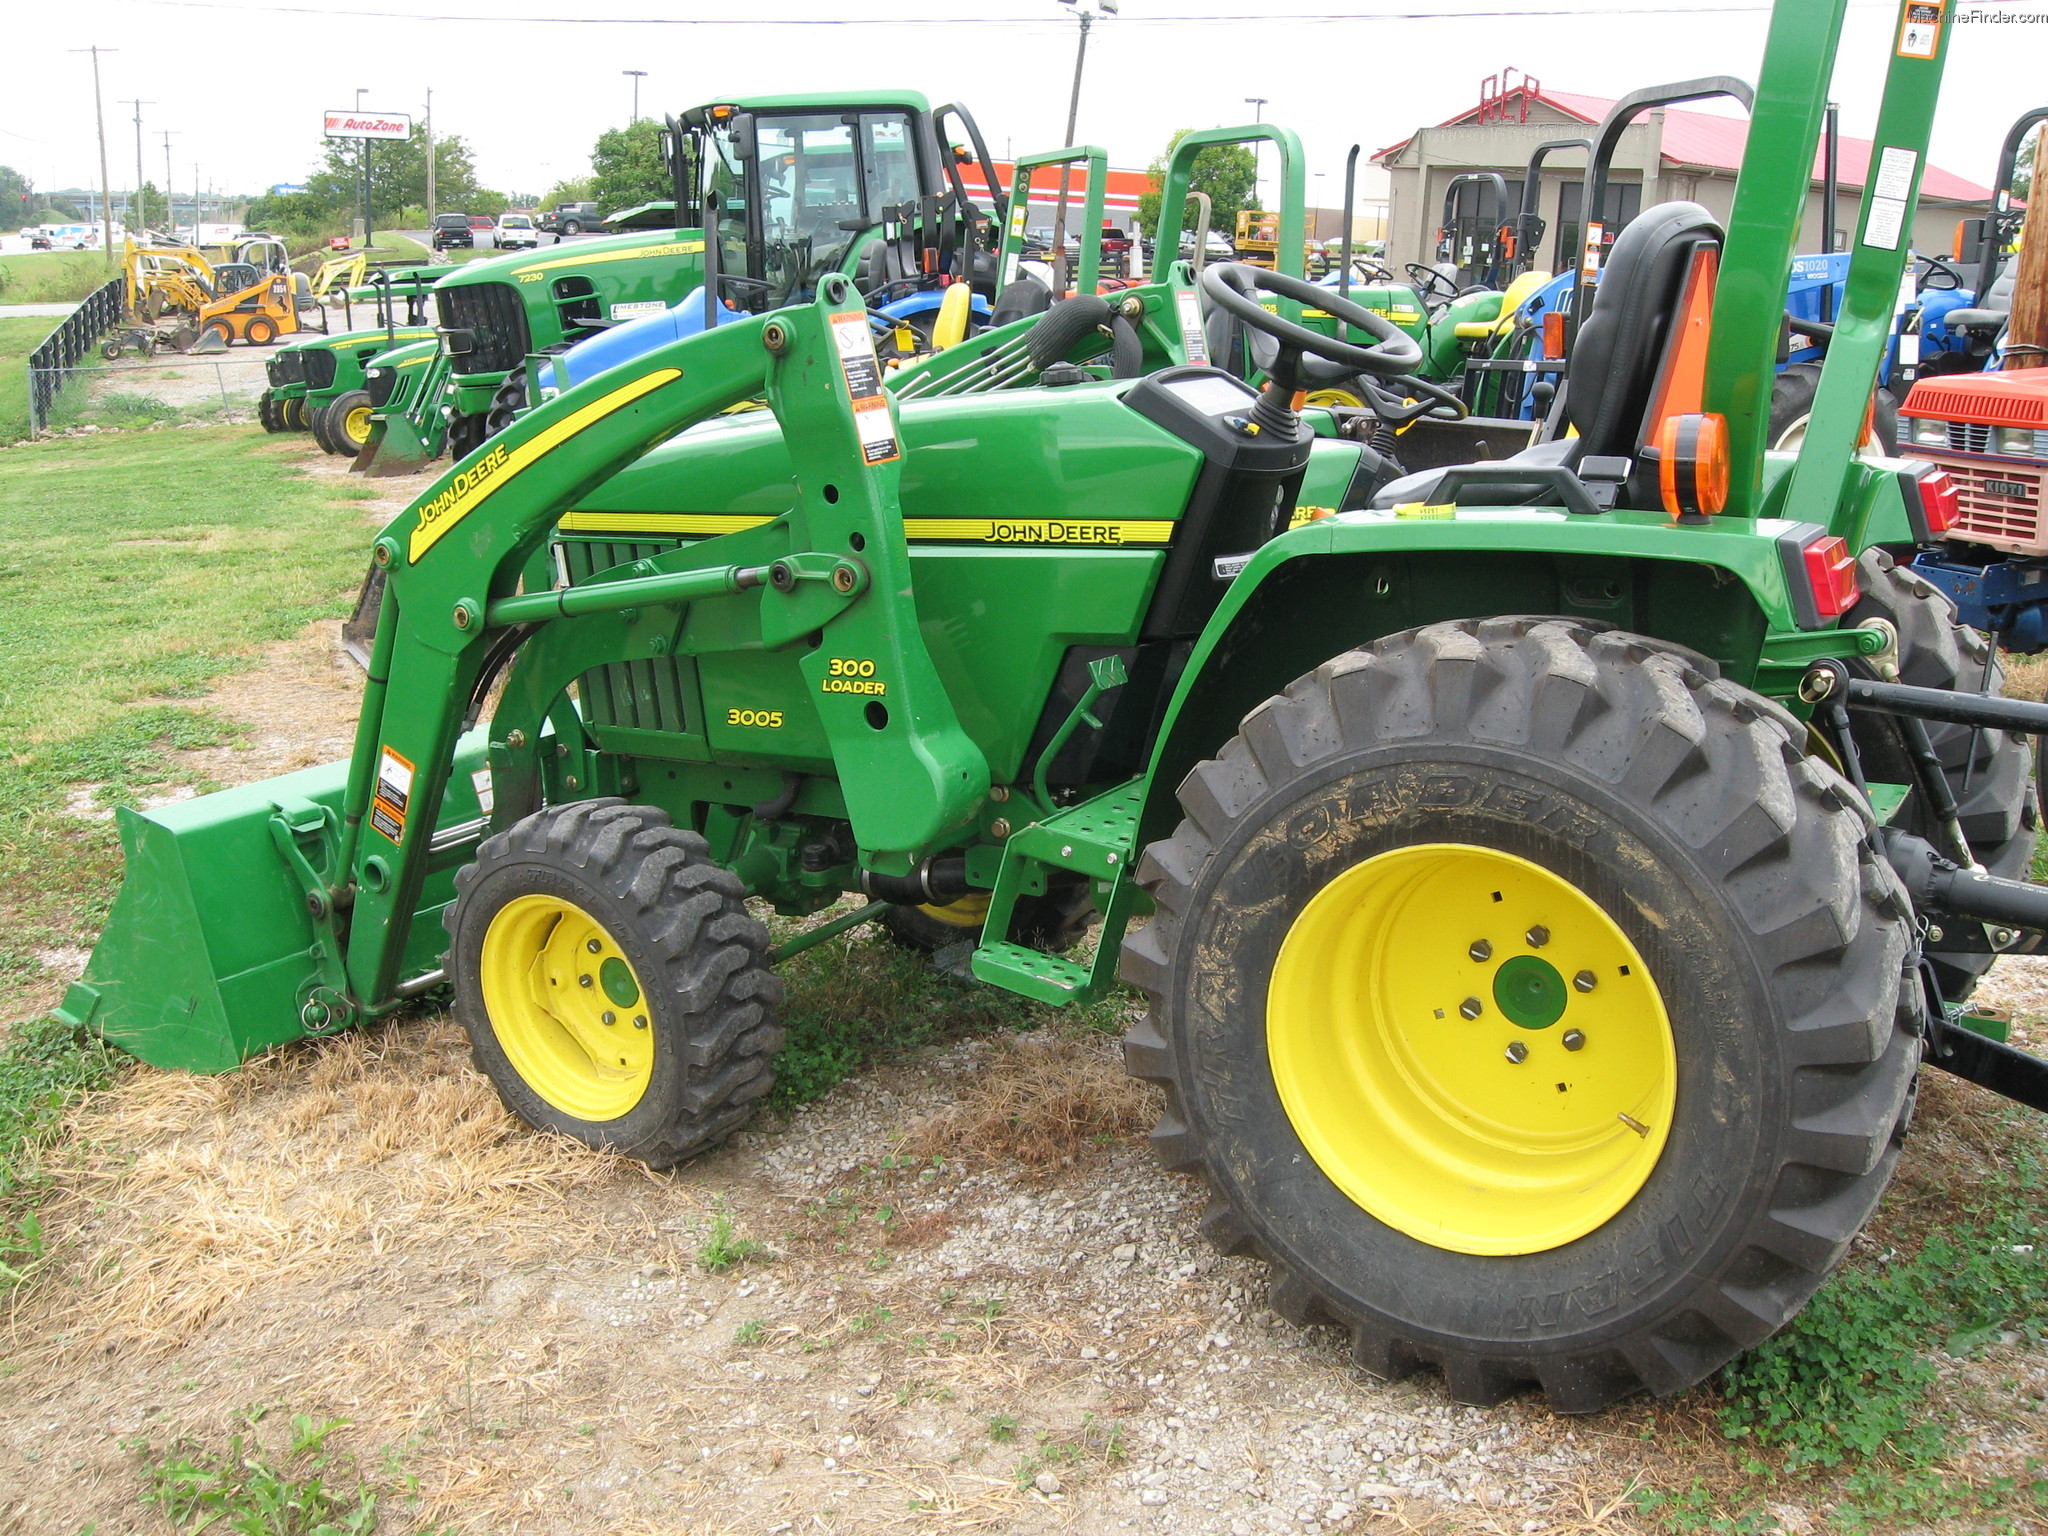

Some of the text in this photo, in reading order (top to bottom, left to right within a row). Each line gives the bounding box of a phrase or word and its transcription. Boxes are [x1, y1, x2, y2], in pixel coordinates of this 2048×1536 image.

[343, 118, 405, 132] AutoZone
[639, 245, 694, 258] JOHN DEERE
[518, 272, 544, 284] 7230
[613, 301, 664, 314] LIMESTONE
[860, 400, 886, 411] WARNING
[416, 443, 509, 532] JOHN DEERE
[1985, 481, 2023, 496] KIOTI
[984, 521, 1122, 542] JOHN DEERE
[829, 658, 876, 677] 300
[821, 679, 887, 696] LOADER
[726, 708, 784, 729] 3005
